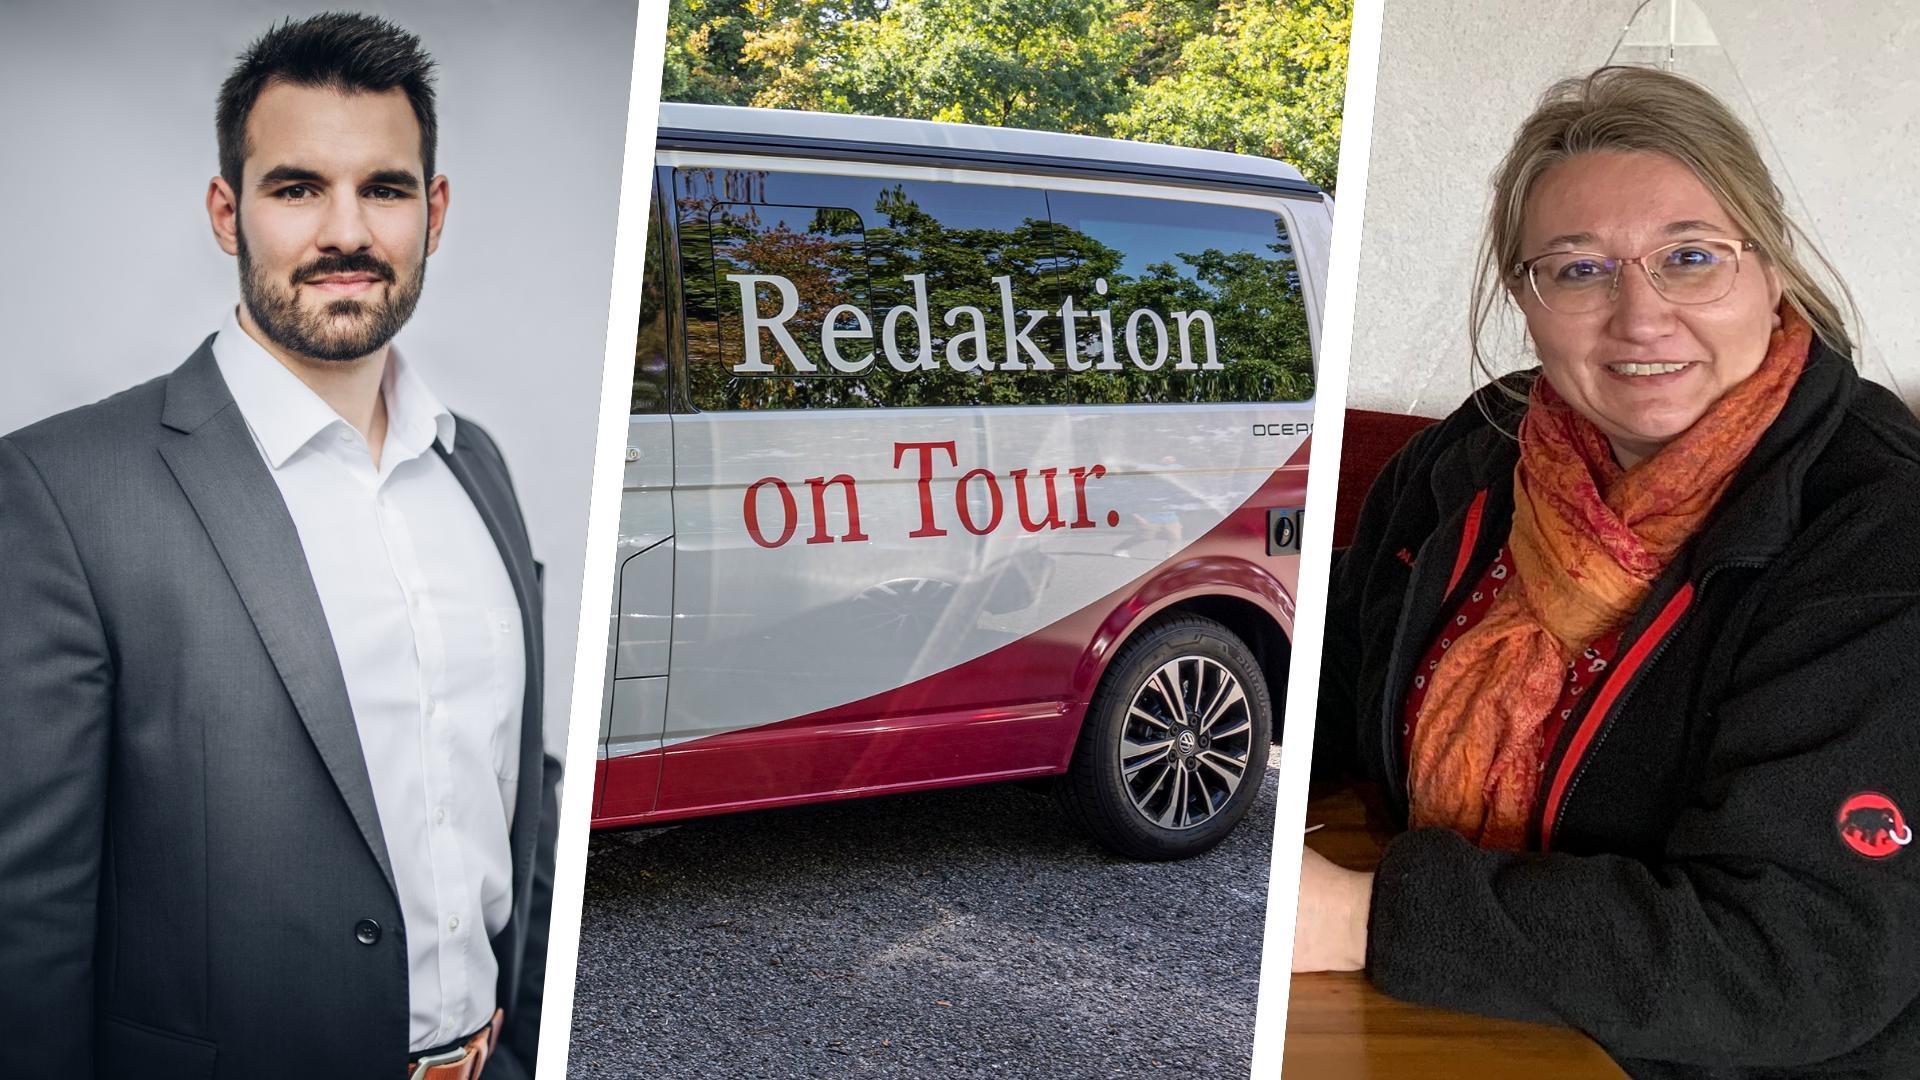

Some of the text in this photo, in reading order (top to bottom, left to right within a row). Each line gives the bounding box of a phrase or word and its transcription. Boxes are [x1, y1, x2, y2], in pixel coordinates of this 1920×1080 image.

[726, 273, 1225, 373] Redaktion
[1252, 423, 1313, 436] OCEA
[743, 440, 1120, 547] on Tour.
